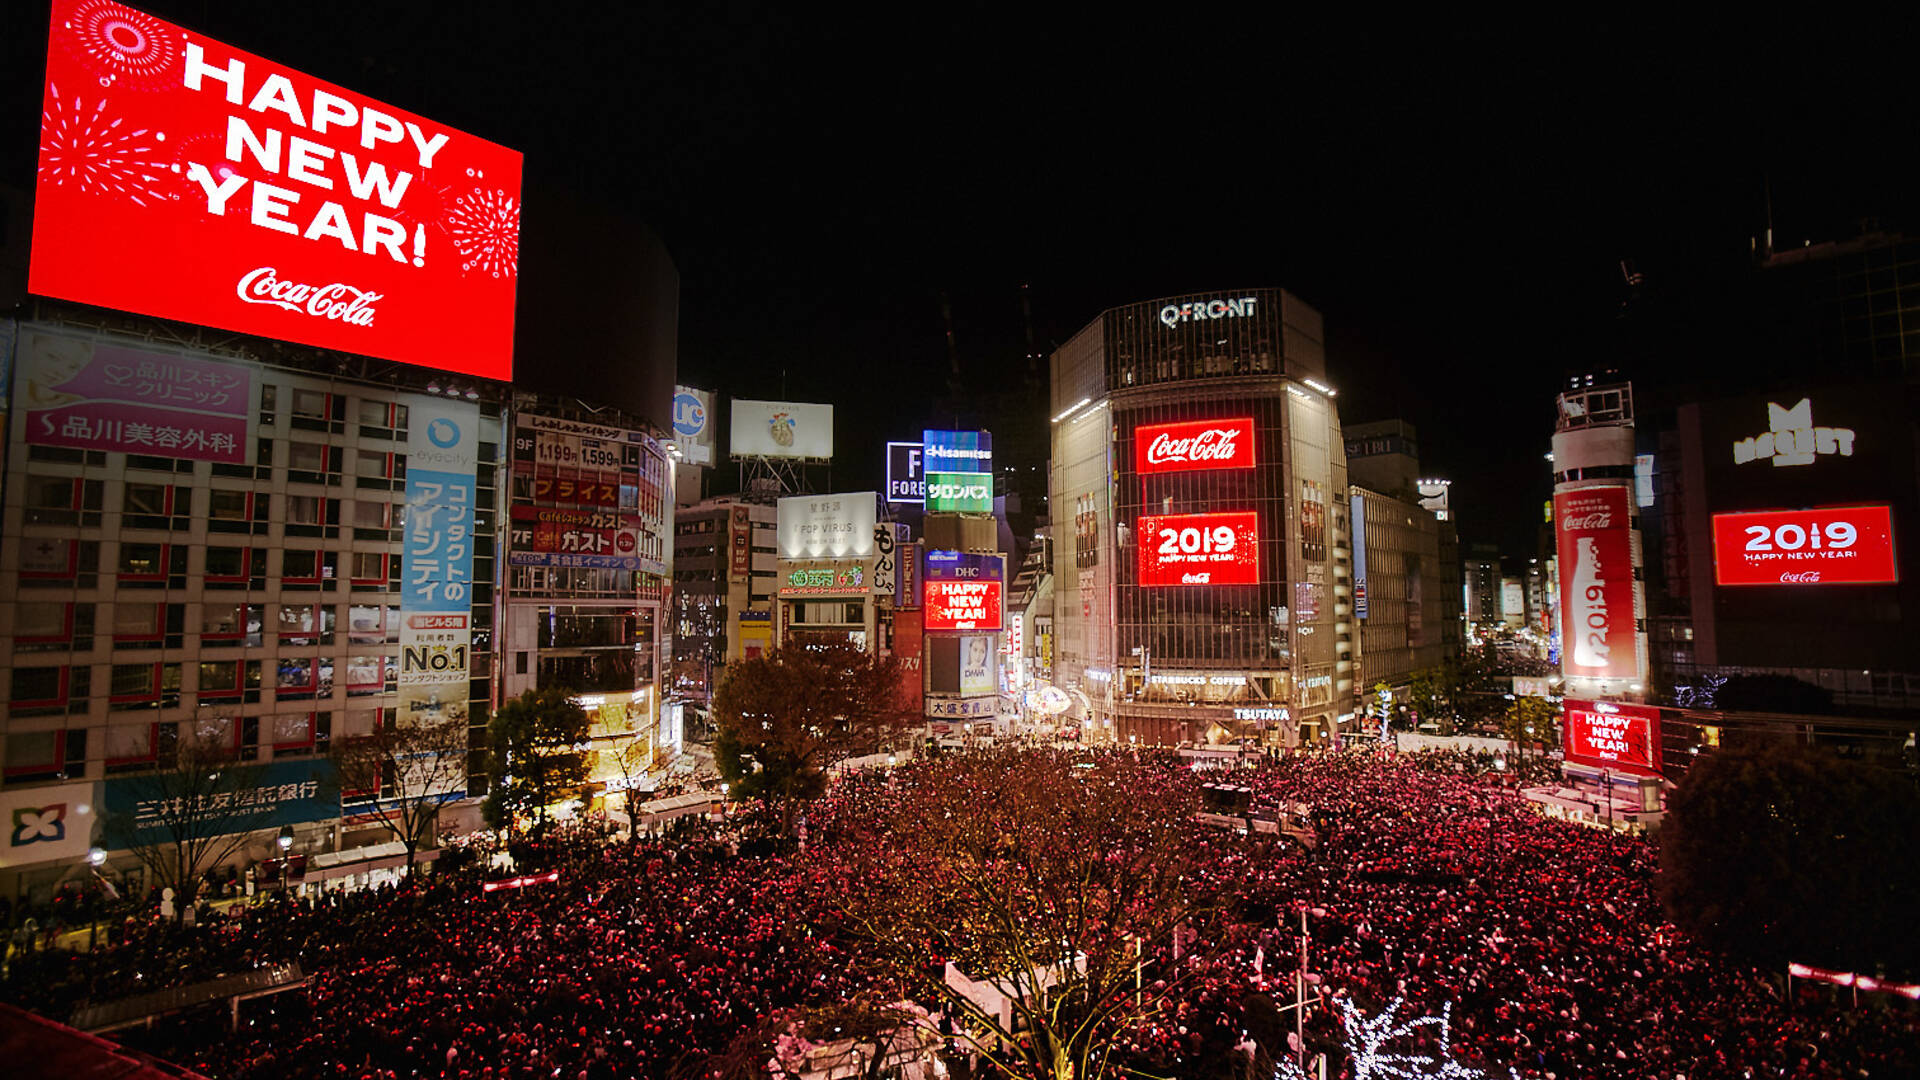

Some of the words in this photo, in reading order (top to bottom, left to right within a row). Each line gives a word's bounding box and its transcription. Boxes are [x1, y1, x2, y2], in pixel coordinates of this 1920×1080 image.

[183, 42, 449, 169] HAPPY
[225, 115, 412, 209] NEW
[187, 161, 425, 267] YEAR!
[236, 267, 384, 327] Coca-Cola
[136, 362, 241, 389] 品川スキン
[136, 381, 230, 407] クリニック
[61, 416, 238, 454] 品川美容外科
[516, 438, 534, 451] 9F
[1148, 429, 1240, 464] Coca-Cola
[417, 451, 469, 465] eyecity
[928, 484, 989, 499] サロンパス
[1563, 512, 1612, 532] Coca-Cola
[412, 482, 443, 601] アイシティ
[444, 485, 467, 601] コンタクトの
[512, 530, 532, 545] 7F
[561, 530, 611, 553] ガスト
[1158, 526, 1235, 554] 2019
[1744, 521, 1858, 551] 2019
[874, 524, 895, 593] もんじゃ
[1744, 552, 1784, 561] HAPPY
[1787, 552, 1815, 560] NEW
[1819, 551, 1857, 559] YEAR!
[955, 567, 980, 577] DHC
[941, 584, 988, 595] HAPPY
[949, 596, 983, 608] NEW
[402, 644, 467, 673] No.1
[1151, 675, 1206, 685] STARBUCKS
[1210, 676, 1246, 685] COFFEE
[1234, 709, 1290, 721] TSUTAYA
[1585, 712, 1631, 729] HAPPY
[1592, 726, 1624, 740] NEW
